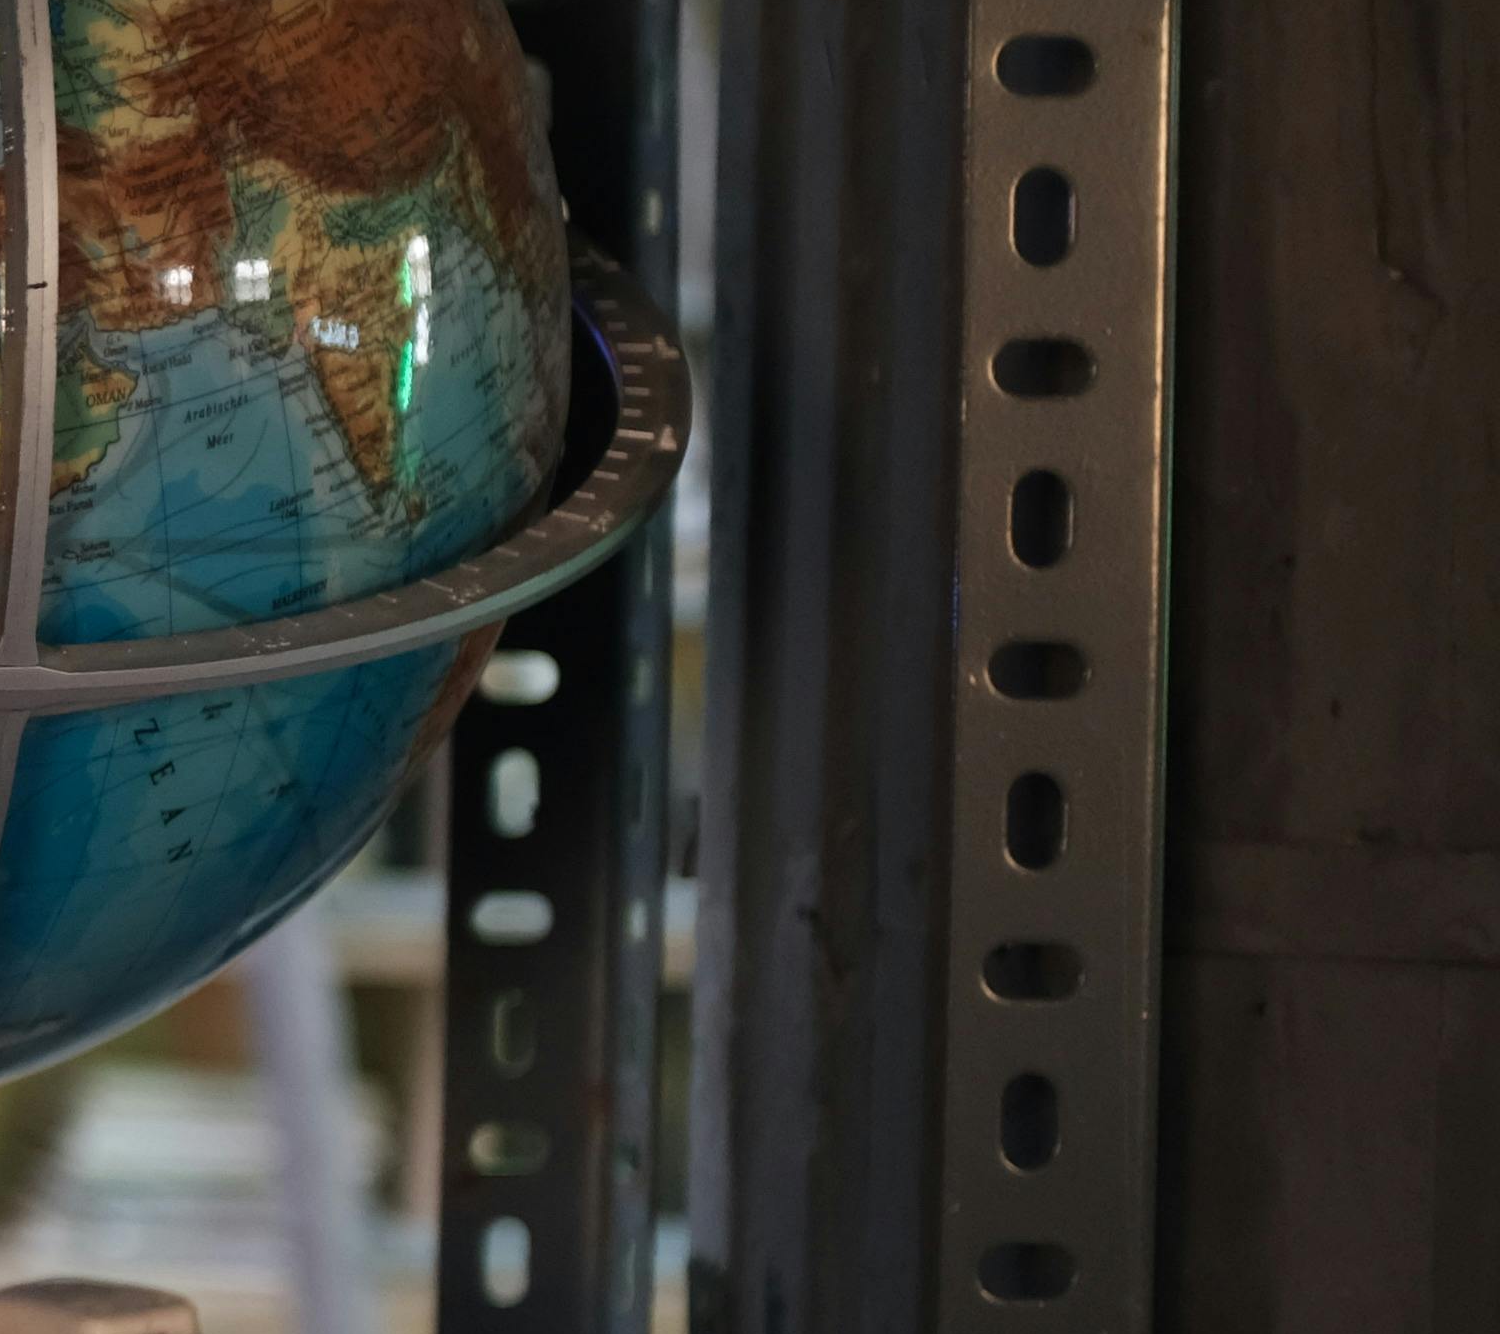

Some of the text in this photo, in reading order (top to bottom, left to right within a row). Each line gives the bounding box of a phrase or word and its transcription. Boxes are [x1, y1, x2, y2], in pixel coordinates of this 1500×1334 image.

[85, 386, 127, 408] OMAN
[183, 393, 249, 425] Arabisches
[205, 431, 235, 450] Meer
[133, 716, 193, 865] ZEAN
